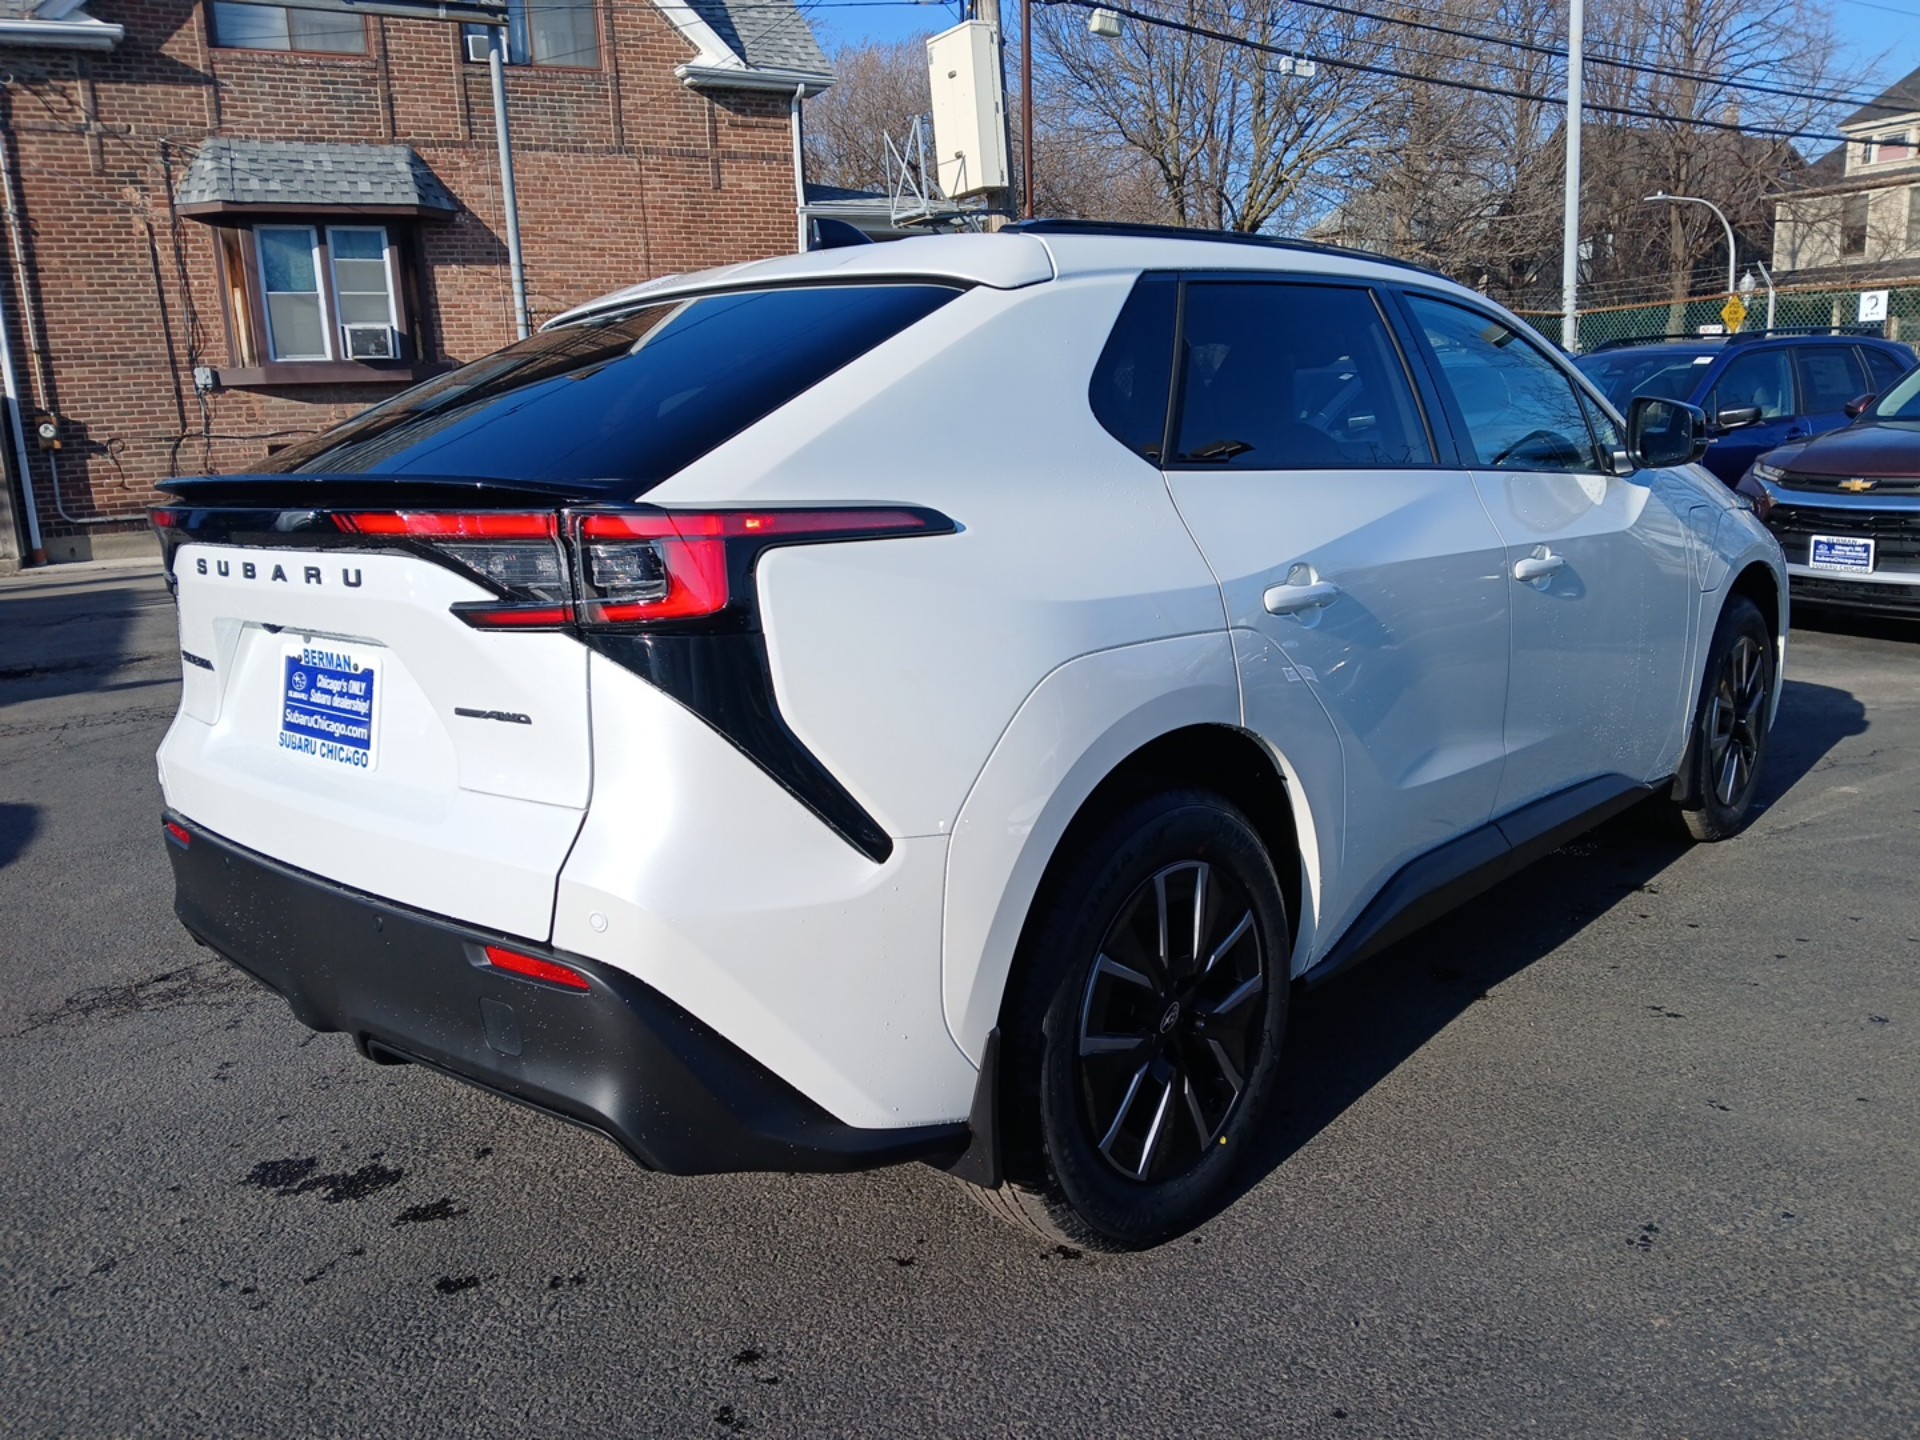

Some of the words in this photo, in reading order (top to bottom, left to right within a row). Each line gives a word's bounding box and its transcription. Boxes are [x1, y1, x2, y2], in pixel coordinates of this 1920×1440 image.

[196, 558, 363, 588] SUBARU
[303, 648, 351, 671] BERMAN
[316, 674, 348, 693] Chicago's
[348, 680, 367, 696] ONLY
[309, 689, 332, 704] Subaru
[332, 694, 370, 715] dealership!
[285, 708, 368, 740] SubaruChicago.com
[279, 731, 317, 756] SUBARU
[319, 741, 369, 768] CHICAGO
